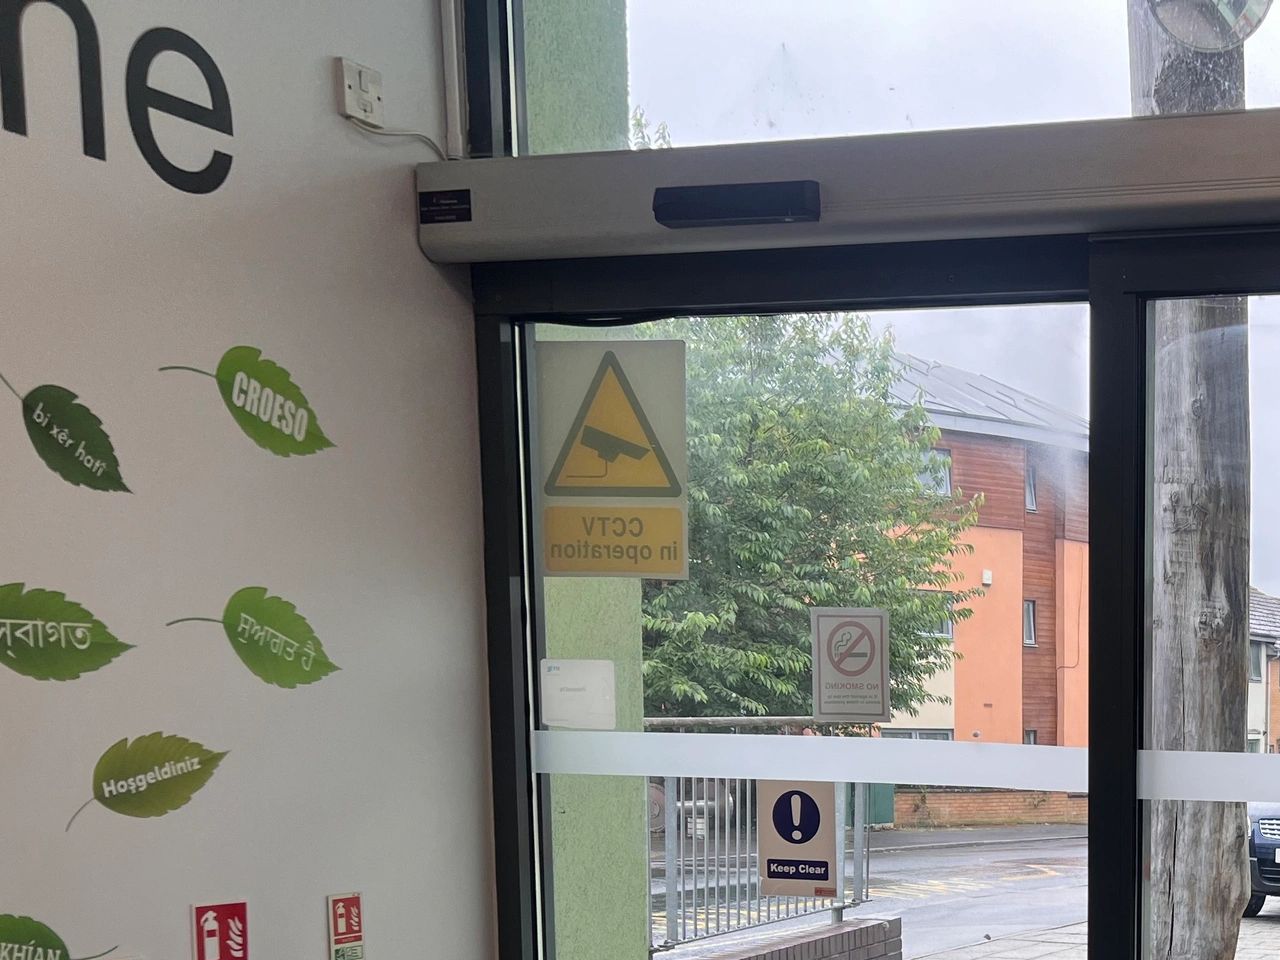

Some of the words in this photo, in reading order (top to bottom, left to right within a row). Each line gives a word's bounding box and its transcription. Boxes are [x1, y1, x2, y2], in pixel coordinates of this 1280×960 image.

[32, 402, 52, 428] bi
[232, 371, 309, 442] CROESO
[102, 756, 202, 798] Hoşgeldiniz
[770, 863, 796, 875] Keep
[798, 864, 826, 874] Clear
